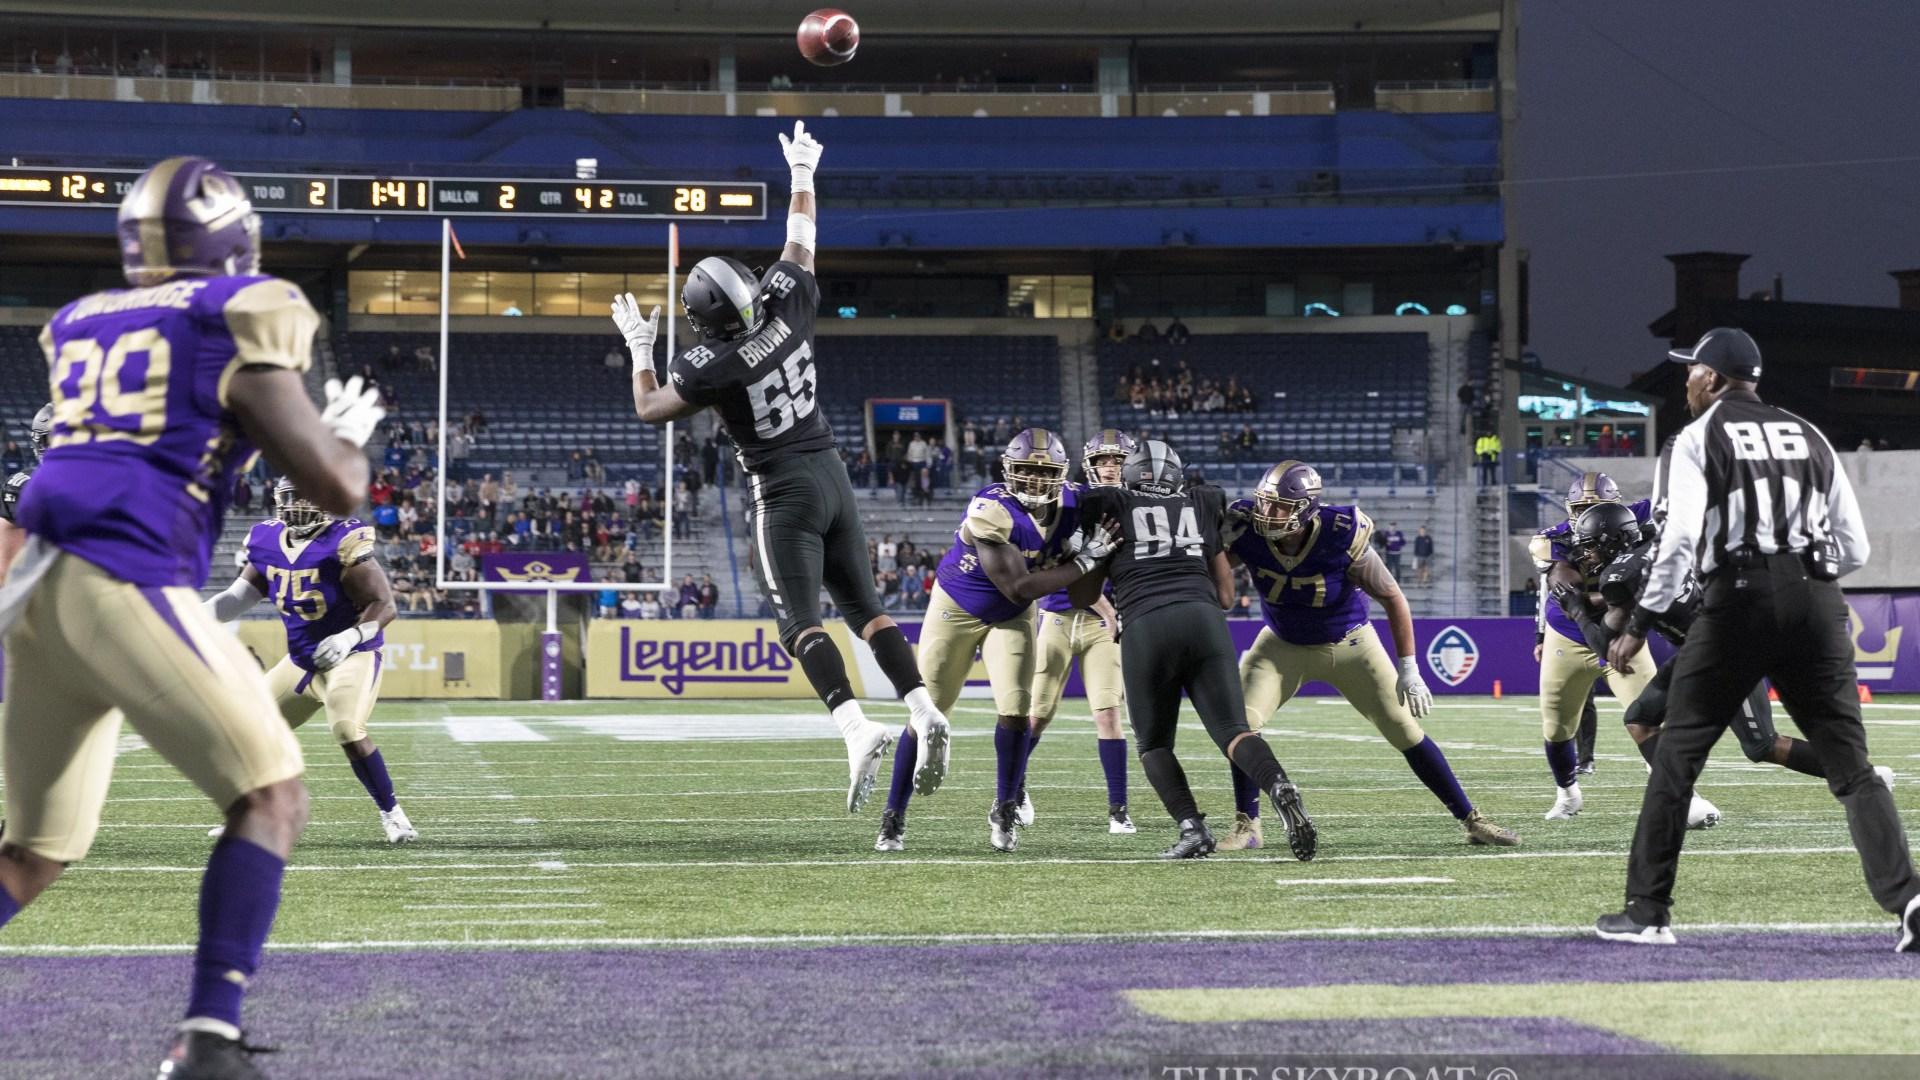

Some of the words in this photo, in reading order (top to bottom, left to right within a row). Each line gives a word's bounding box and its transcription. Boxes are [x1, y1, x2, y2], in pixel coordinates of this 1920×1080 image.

[62, 175, 86, 199] 12
[253, 186, 267, 199] TO
[269, 186, 285, 199] GO
[309, 182, 326, 205] 2
[499, 185, 515, 208] 2
[540, 191, 562, 205] QTR
[674, 188, 706, 211] 28
[737, 316, 793, 369] BROWN
[683, 345, 715, 369] 55
[1723, 421, 1810, 461] 86
[1140, 484, 1171, 495] Riddell
[1132, 506, 1205, 560] 94
[1332, 513, 1352, 531] 77
[266, 565, 328, 621] 75
[1257, 568, 1326, 608] 77
[383, 643, 438, 671] TL
[620, 626, 793, 695] Legends
